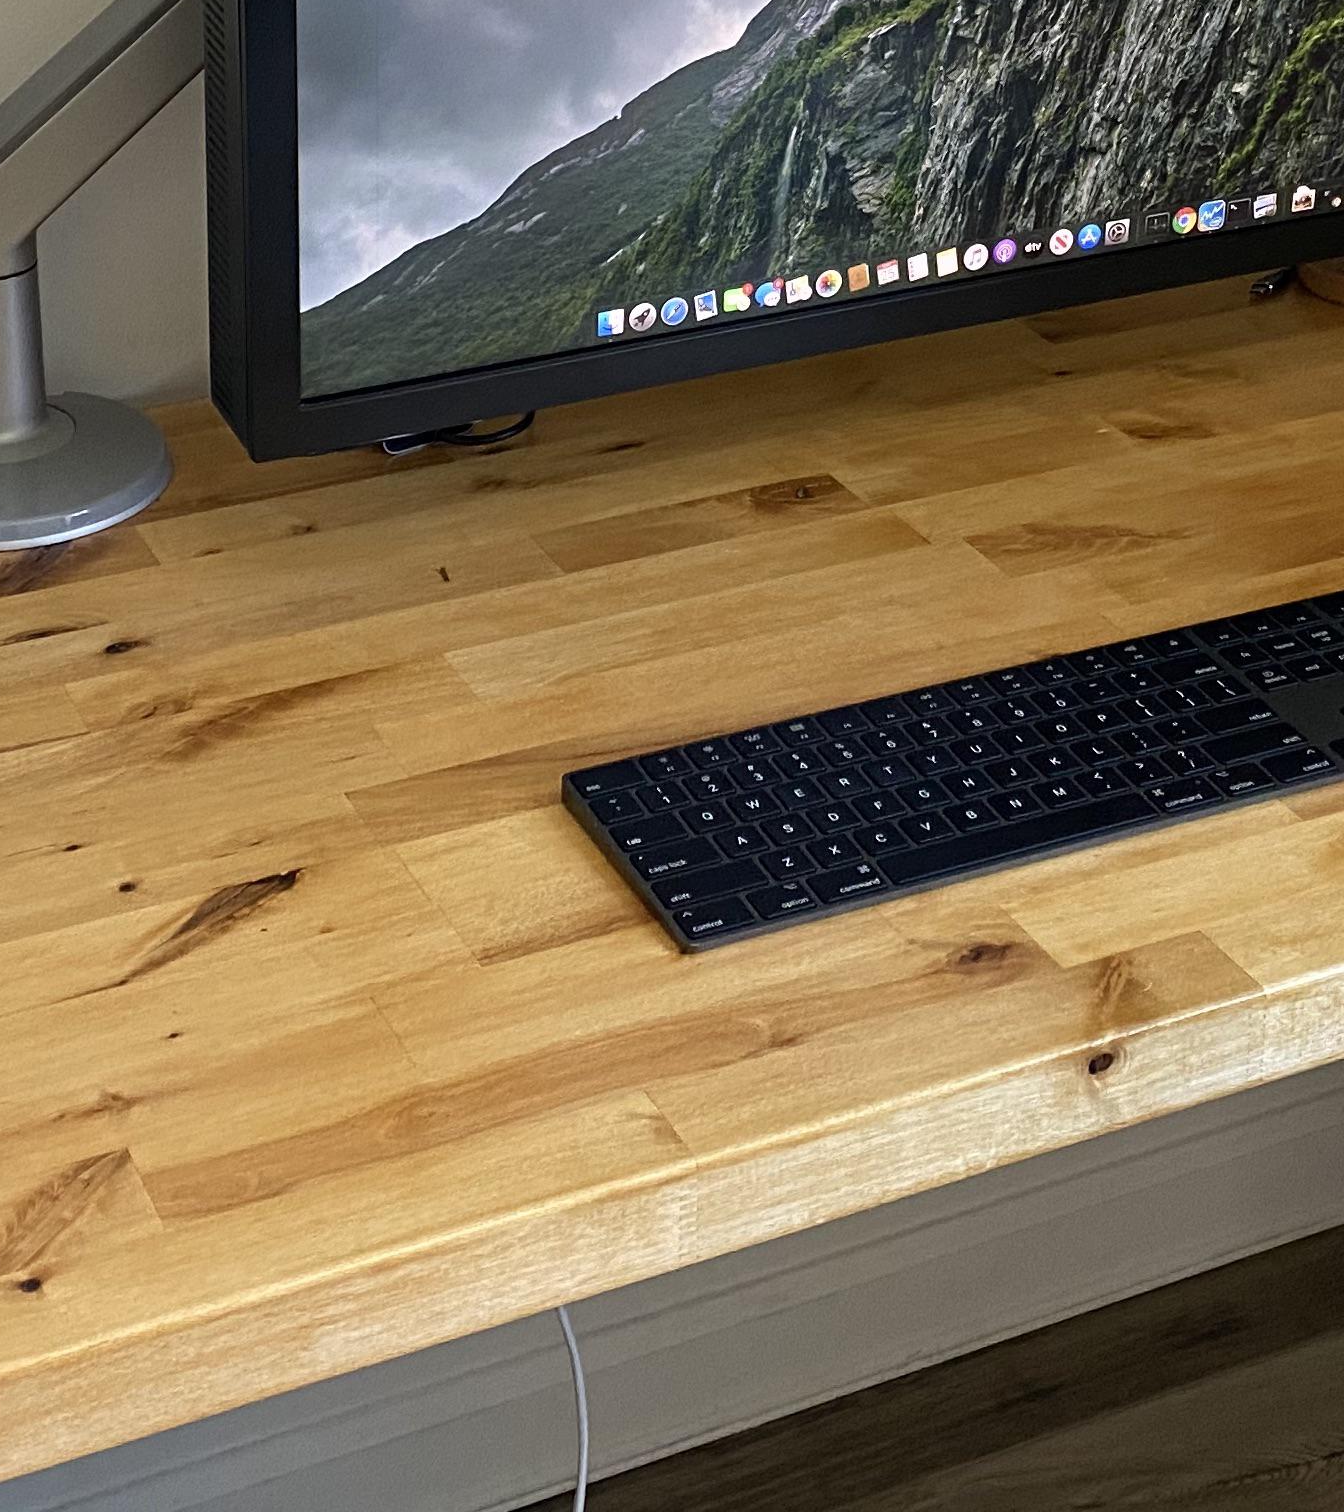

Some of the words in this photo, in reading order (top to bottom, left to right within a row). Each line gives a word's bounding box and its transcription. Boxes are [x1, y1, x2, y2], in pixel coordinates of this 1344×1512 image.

[1097, 714, 1106, 722] P
[970, 745, 982, 753] U
[1049, 757, 1061, 765] K
[883, 766, 892, 774] T
[1010, 768, 1017, 776] J
[753, 773, 763, 781] 3
[839, 778, 850, 786] R
[963, 778, 975, 787] H
[708, 784, 719, 792] 2
[1053, 787, 1067, 796] M
[794, 789, 805, 797] E
[746, 799, 759, 809] W
[874, 801, 882, 810] F
[1009, 799, 1022, 808] N
[702, 812, 713, 820] Q
[828, 813, 839, 821] D
[783, 824, 793, 833] S
[920, 822, 930, 830] V
[738, 836, 748, 845] A
[876, 834, 887, 842] C
[828, 845, 841, 855] X
[782, 857, 794, 867] Z
